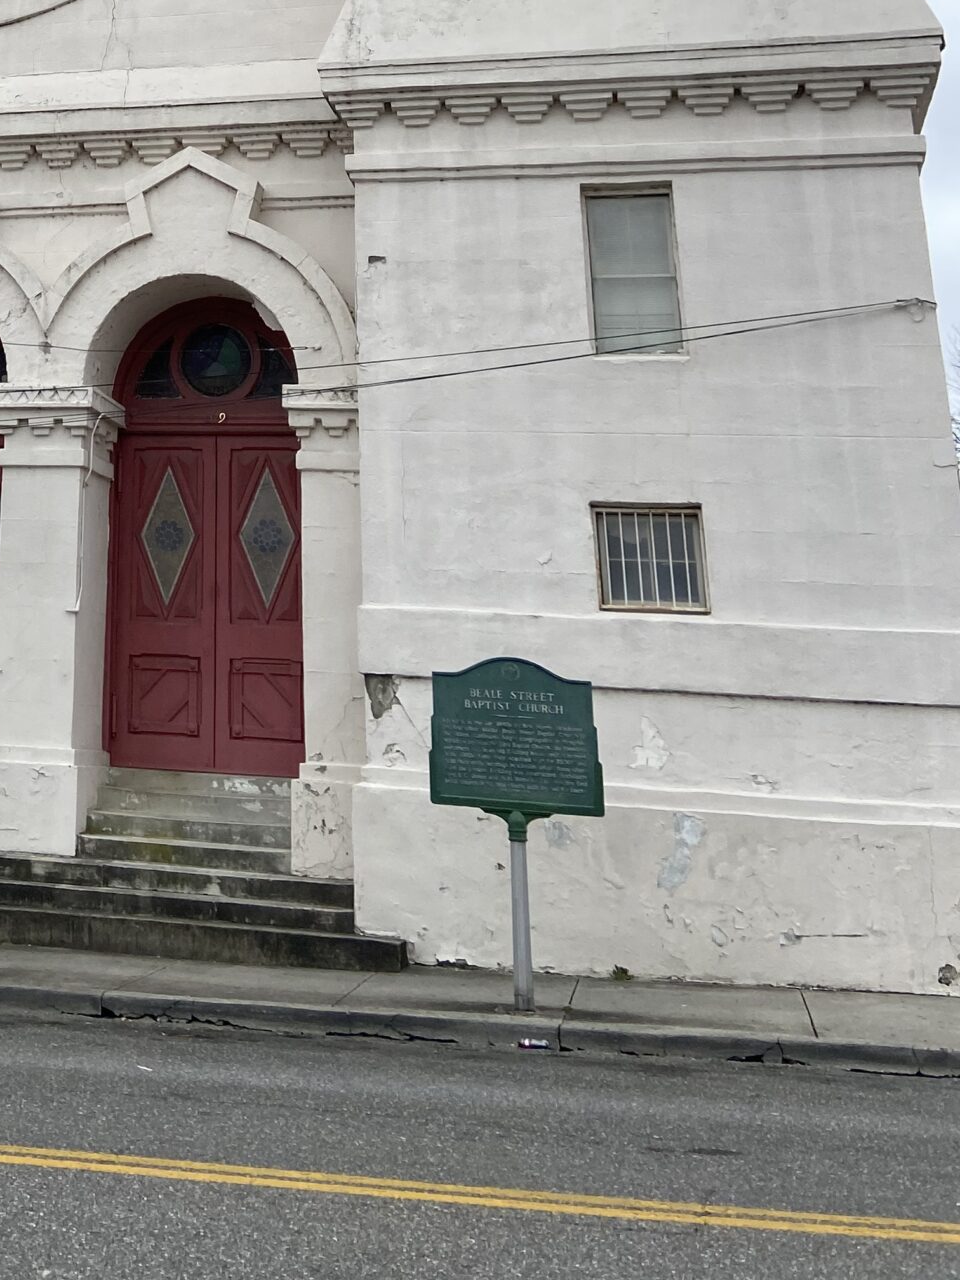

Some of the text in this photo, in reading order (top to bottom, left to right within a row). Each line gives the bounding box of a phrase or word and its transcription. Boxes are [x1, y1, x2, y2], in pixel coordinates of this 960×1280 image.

[469, 688, 555, 703] BEALE STREET
[464, 699, 564, 715] BAPTIST CHURCH
